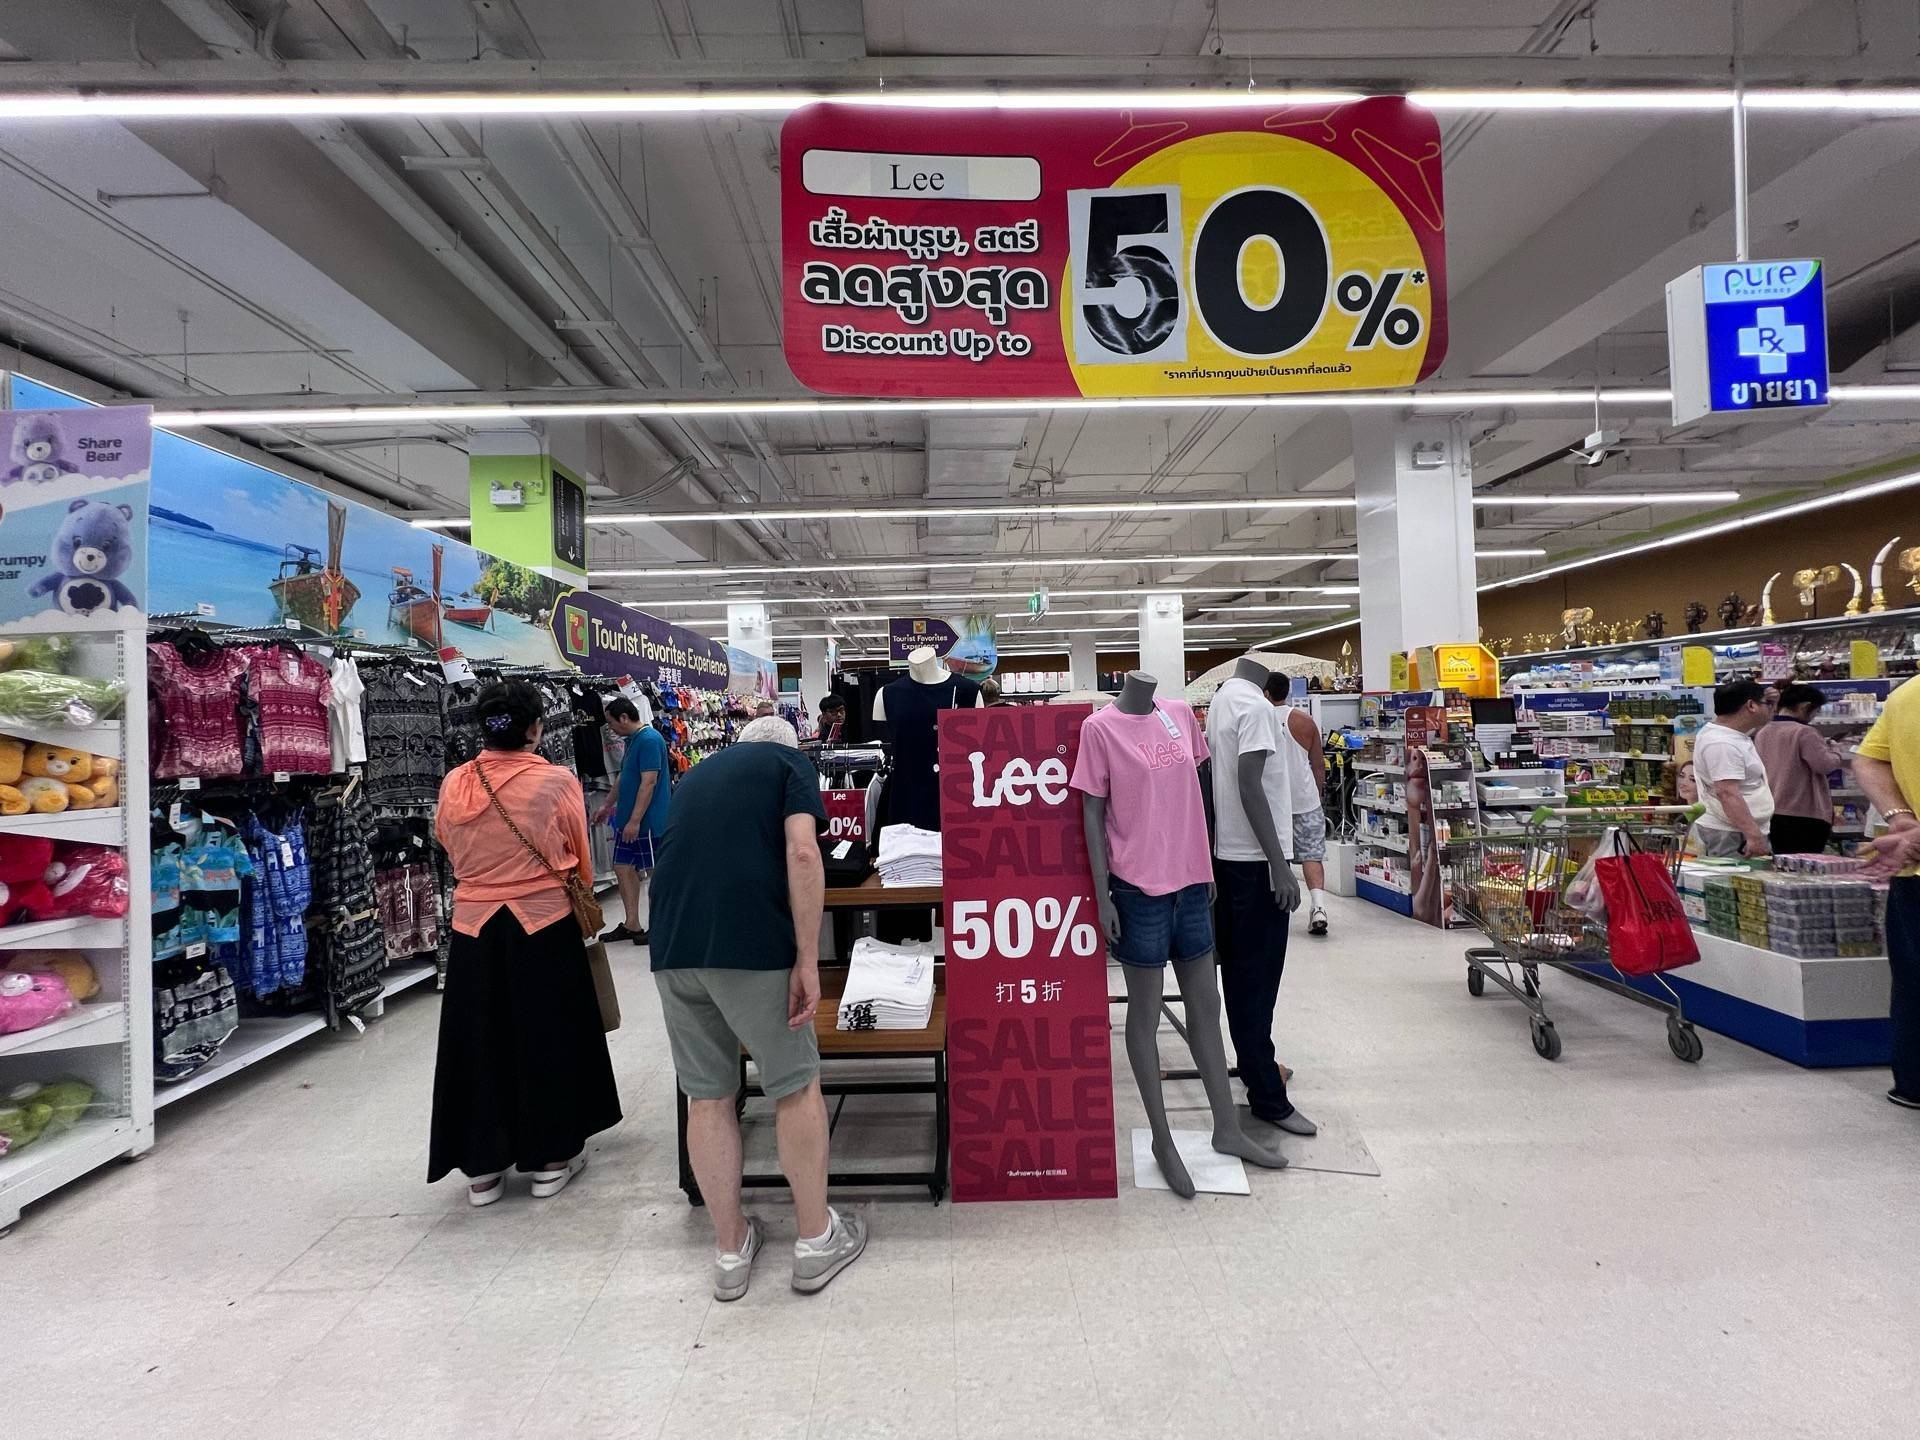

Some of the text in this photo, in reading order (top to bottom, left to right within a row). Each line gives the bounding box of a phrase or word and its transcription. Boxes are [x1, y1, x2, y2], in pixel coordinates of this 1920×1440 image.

[889, 163, 945, 191] Lee
[811, 207, 1038, 258] เสื้อผ้าบุรุษ, สตรี
[801, 263, 1048, 324] ลดสูงสุด
[1725, 265, 1797, 295] pure
[824, 326, 1031, 360] Discount Up to
[1759, 328, 1784, 353] Rx
[1731, 379, 1817, 404] ขายยา
[77, 437, 122, 450] Share
[86, 451, 122, 462] Bear
[0, 553, 46, 569] rumpy
[0, 568, 21, 580] ear
[591, 617, 727, 677] Tourist Favorites Experience
[893, 633, 947, 642] Tourist Favorites
[1137, 741, 1185, 769] Lee
[968, 752, 1068, 807] Lee
[832, 792, 847, 800] Lee
[951, 1015, 1108, 1072] SALE
[953, 1076, 1111, 1135] SALE
[955, 1136, 1113, 1197] SALE
